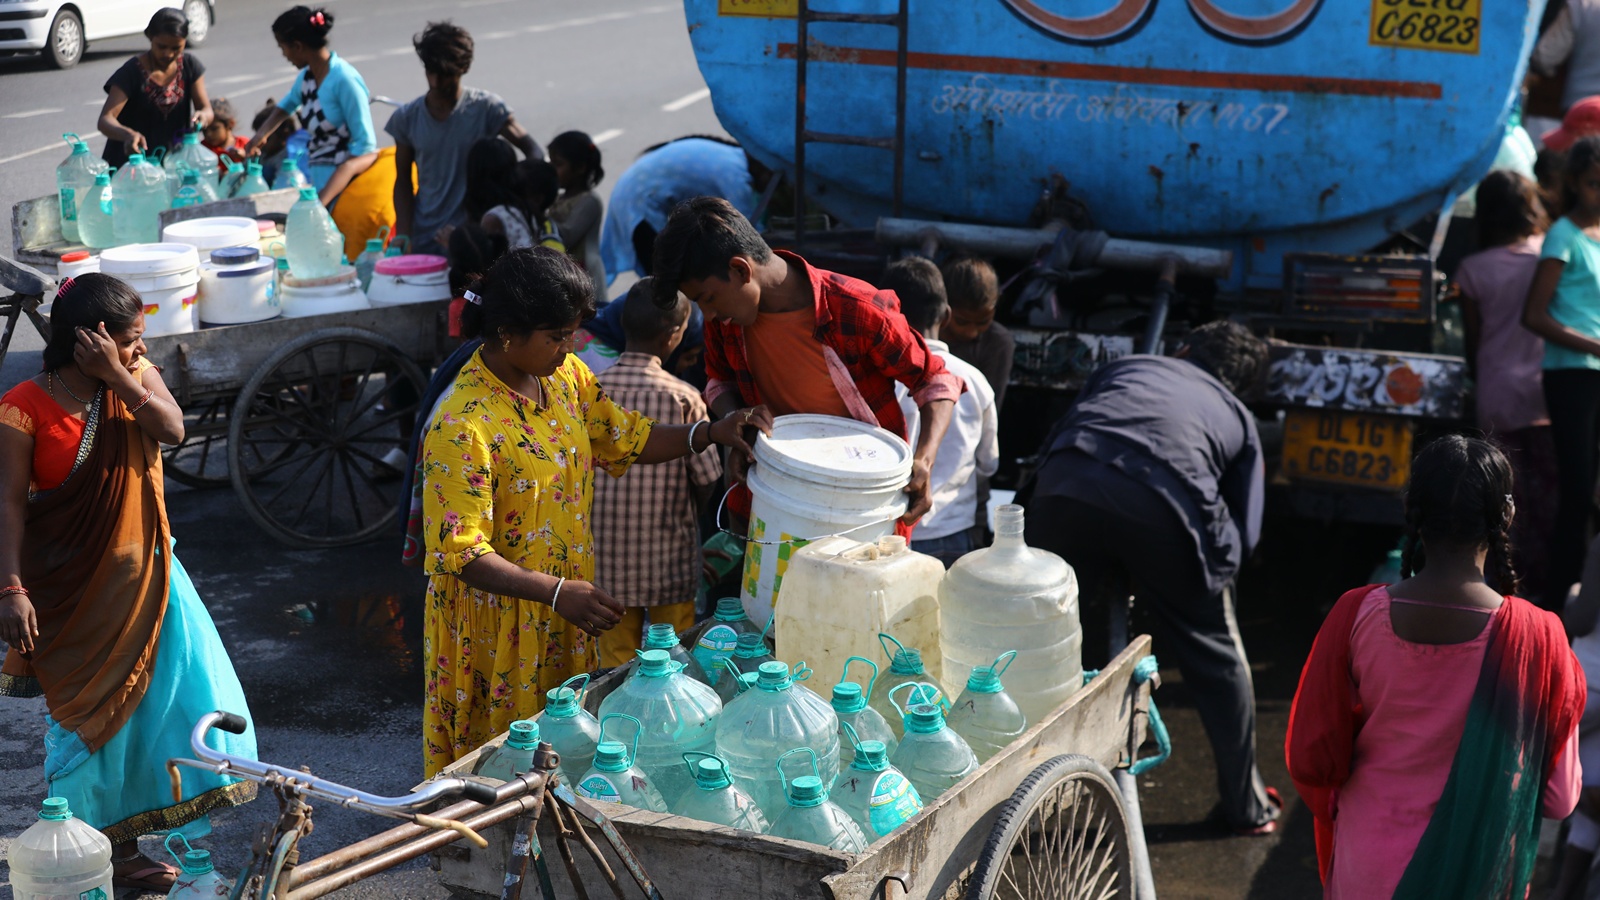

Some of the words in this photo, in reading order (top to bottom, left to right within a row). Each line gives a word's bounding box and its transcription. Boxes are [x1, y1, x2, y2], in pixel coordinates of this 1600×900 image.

[1377, 10, 1479, 45] C6823
[1308, 446, 1392, 482] C6823
[588, 780, 608, 790] Bisleri
